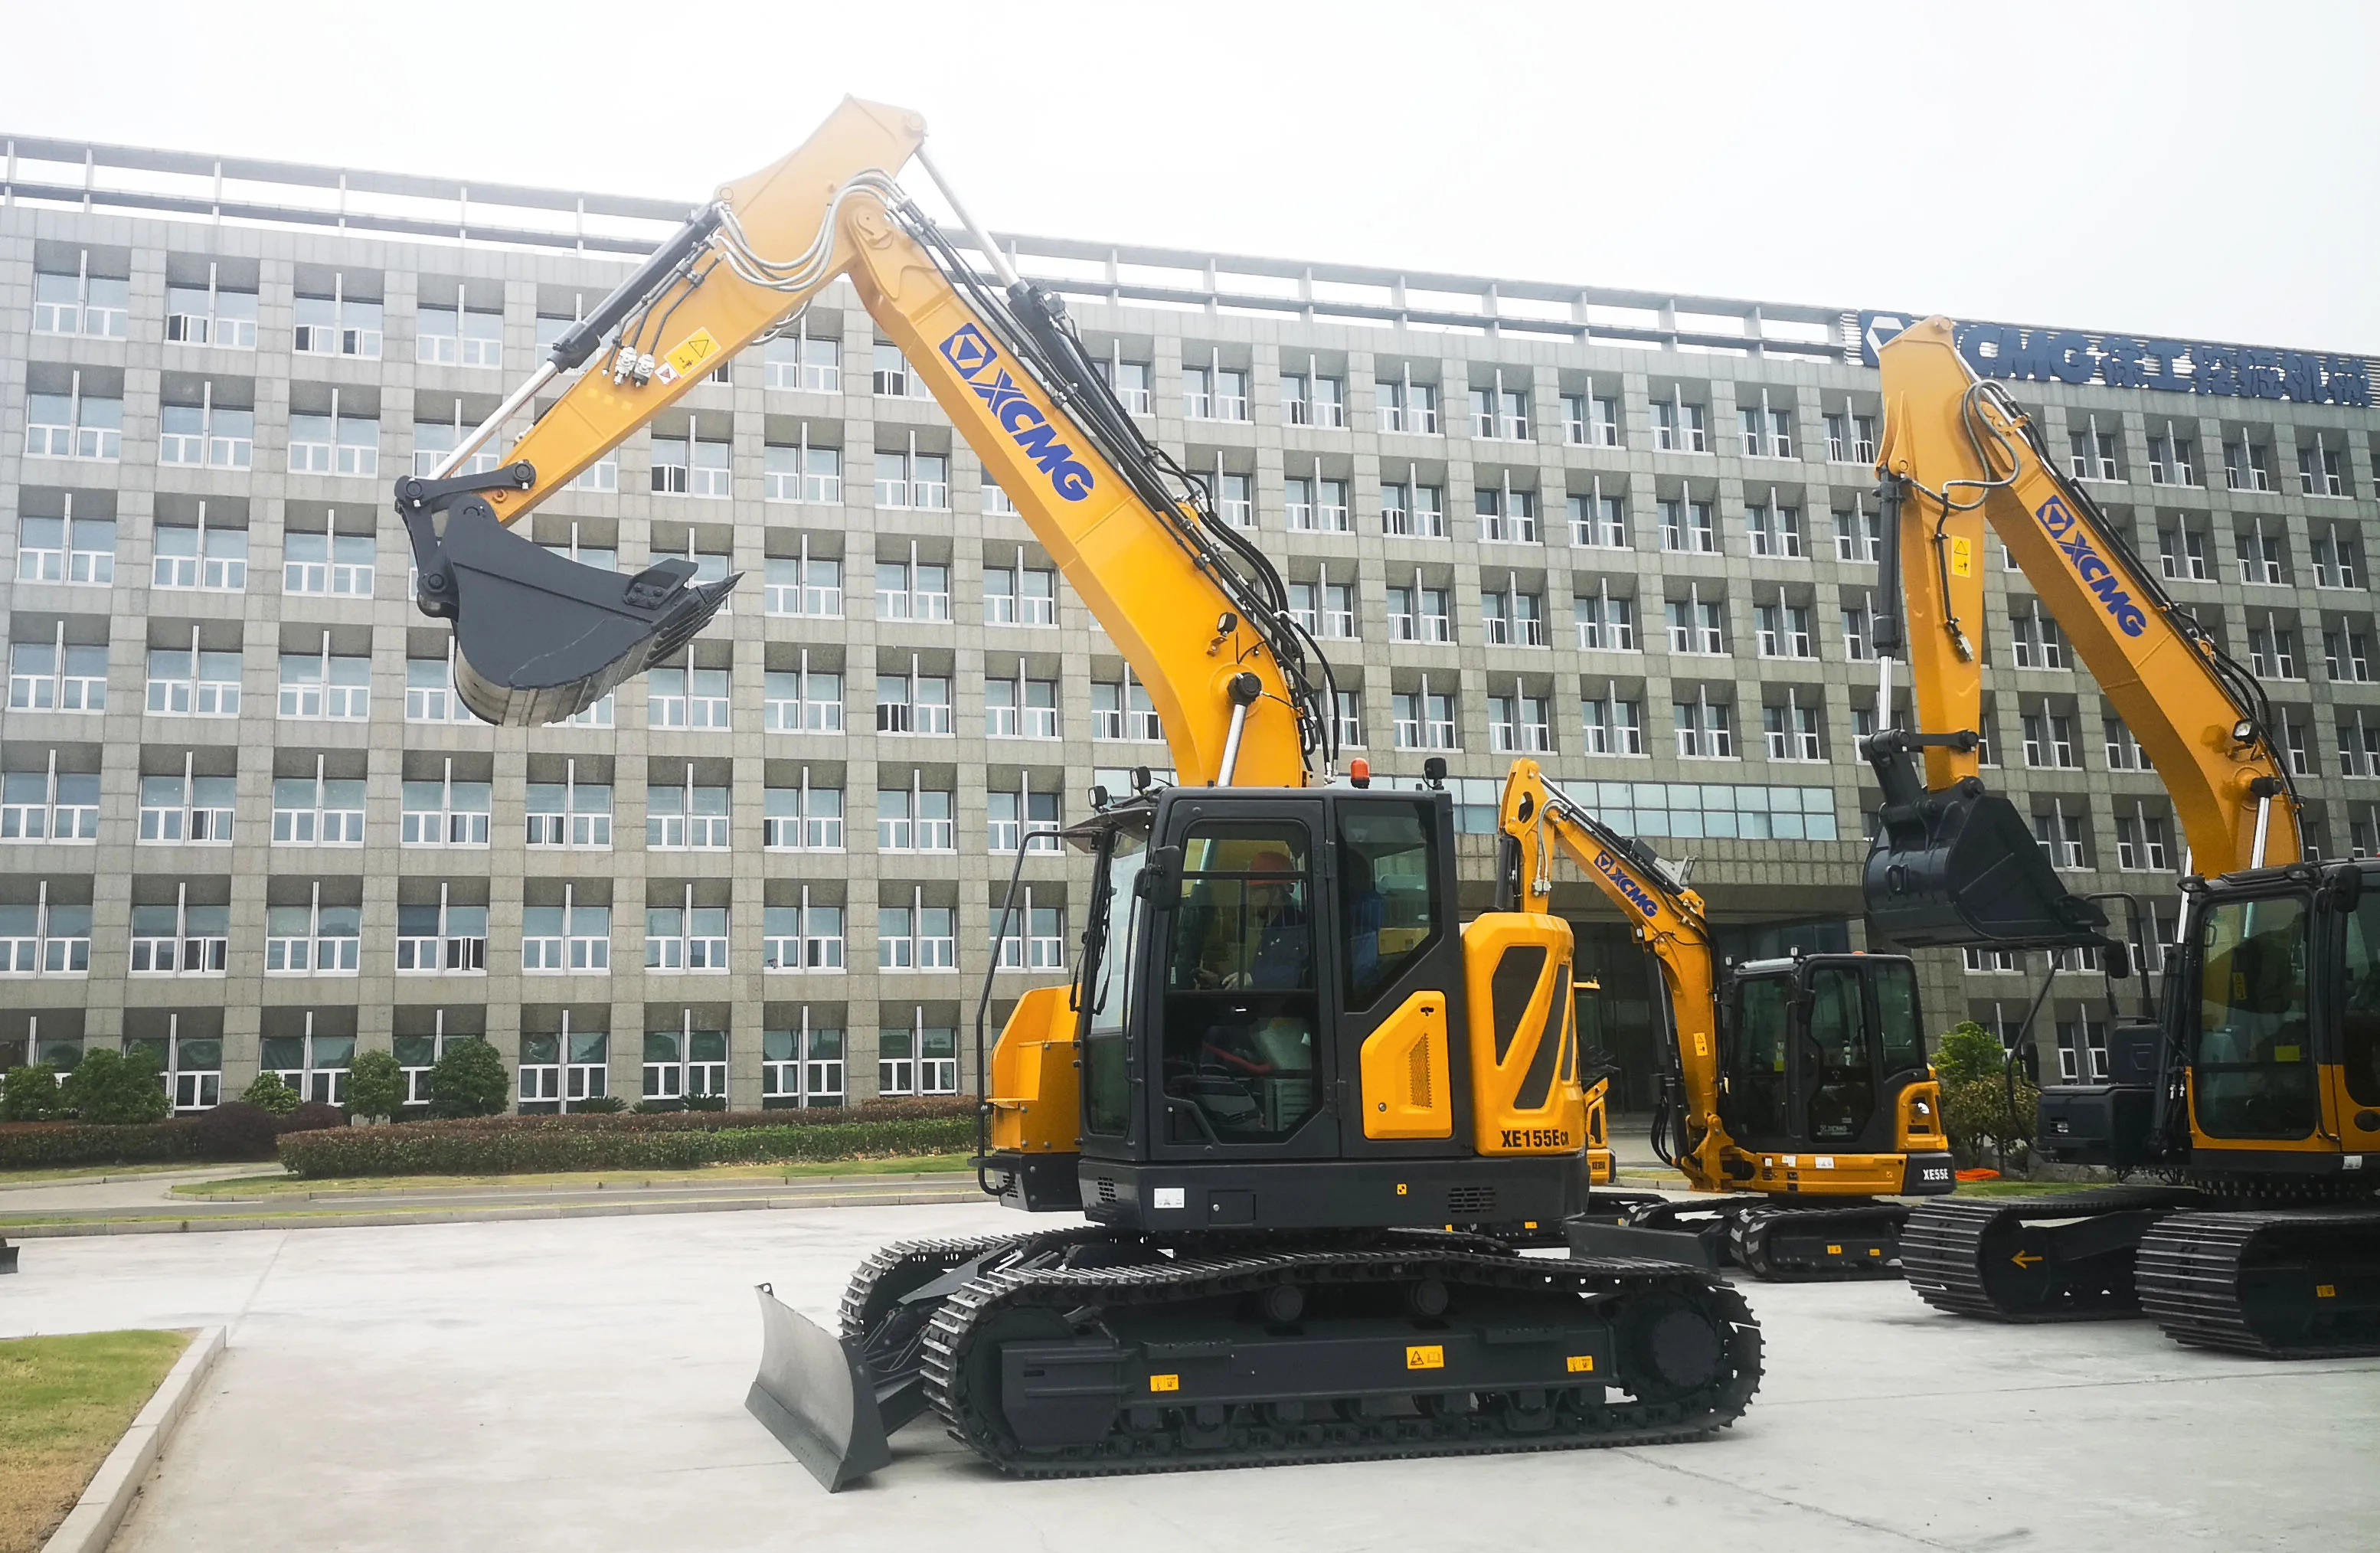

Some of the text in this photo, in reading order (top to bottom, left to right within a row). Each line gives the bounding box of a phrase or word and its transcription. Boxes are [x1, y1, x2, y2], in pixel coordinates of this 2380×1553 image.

[967, 367, 1094, 502] XCMG
[2056, 530, 2146, 638] XCMG
[1607, 866, 1658, 917] XCMG
[1922, 1168, 1949, 1181] XE55E
